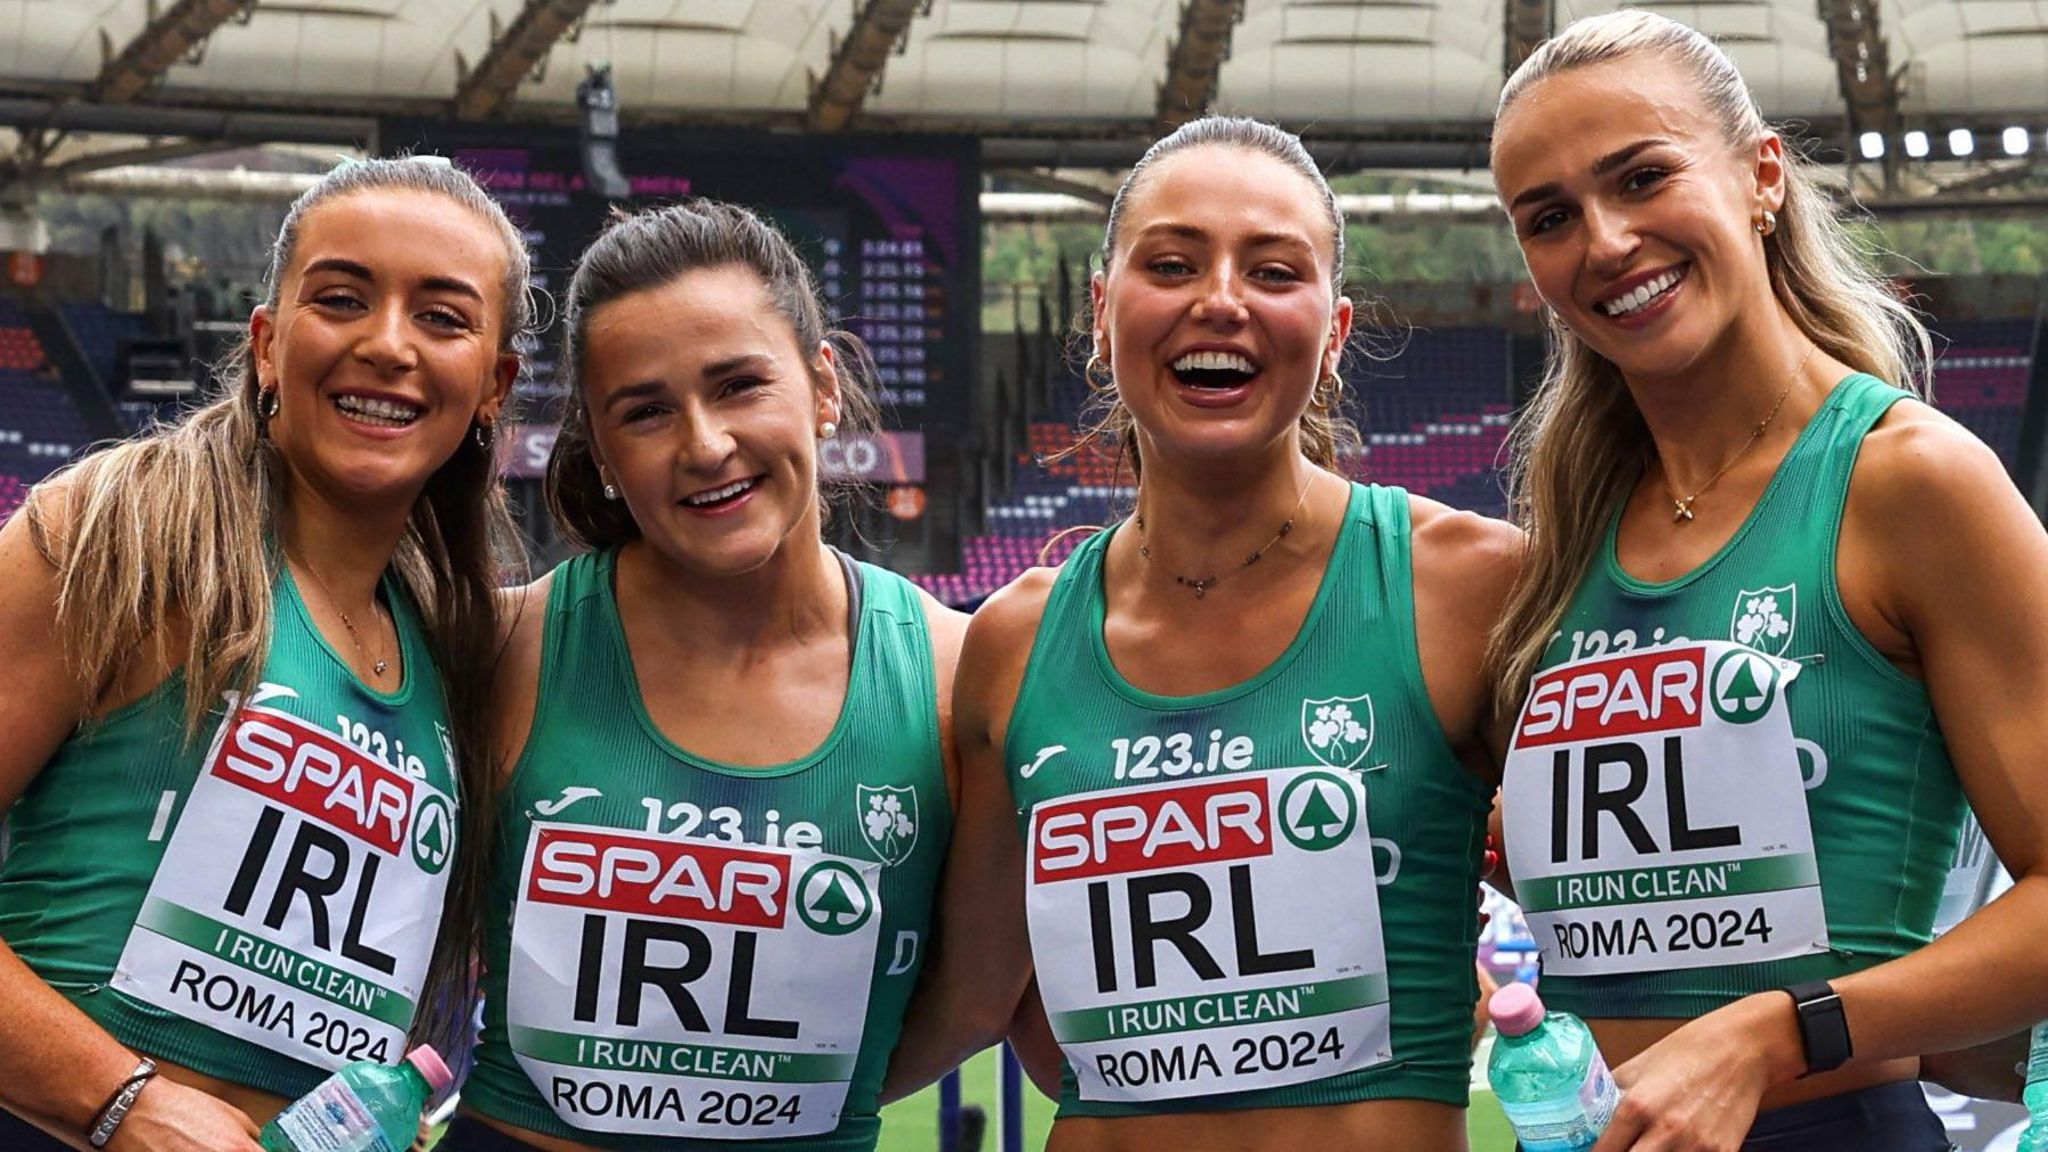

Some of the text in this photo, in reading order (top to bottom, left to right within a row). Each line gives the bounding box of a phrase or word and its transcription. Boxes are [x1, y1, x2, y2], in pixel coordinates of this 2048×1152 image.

[1524, 661, 1698, 736] SPAR
[226, 721, 408, 842] SPAR
[1111, 729, 1254, 779] 123.ie
[1039, 791, 1265, 871] SPAR
[1551, 736, 1741, 863] IRL
[223, 805, 396, 976] IRL
[537, 841, 782, 917] SPAR
[1556, 884, 1562, 904] I
[1569, 874, 1625, 902] RUN
[214, 929, 229, 953] I
[230, 935, 290, 980] RUN
[1087, 864, 1315, 994] IRL
[1553, 907, 1773, 958] ROMA 2024
[169, 960, 391, 1064] ROMA 2024
[573, 913, 799, 1040] IRL
[577, 1040, 586, 1062] I
[593, 1041, 662, 1068] RUN
[1107, 1010, 1115, 1035] I
[1122, 1002, 1187, 1032] RUN
[1096, 1027, 1346, 1089] ROMA 2024
[551, 1076, 802, 1127] ROMA 2024
